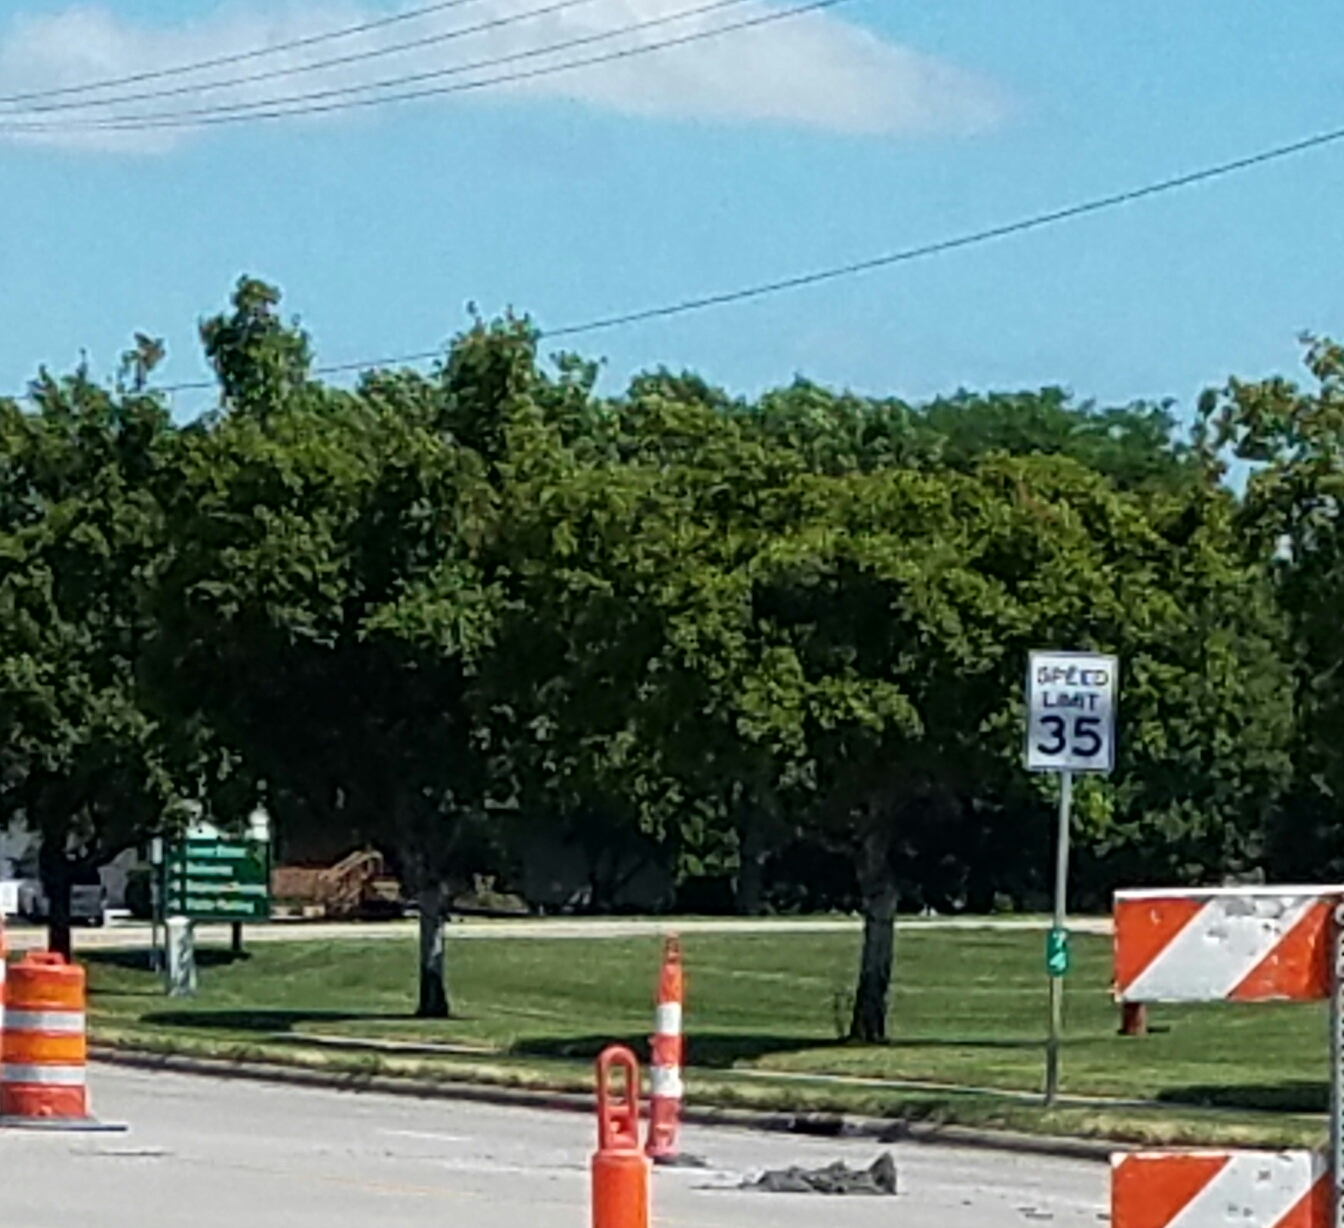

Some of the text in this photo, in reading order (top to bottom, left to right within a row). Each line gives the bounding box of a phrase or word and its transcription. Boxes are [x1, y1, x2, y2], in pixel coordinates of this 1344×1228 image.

[1037, 665, 1110, 686] SPEED
[1042, 691, 1101, 711] LIMIT
[1037, 714, 1103, 757] 35
